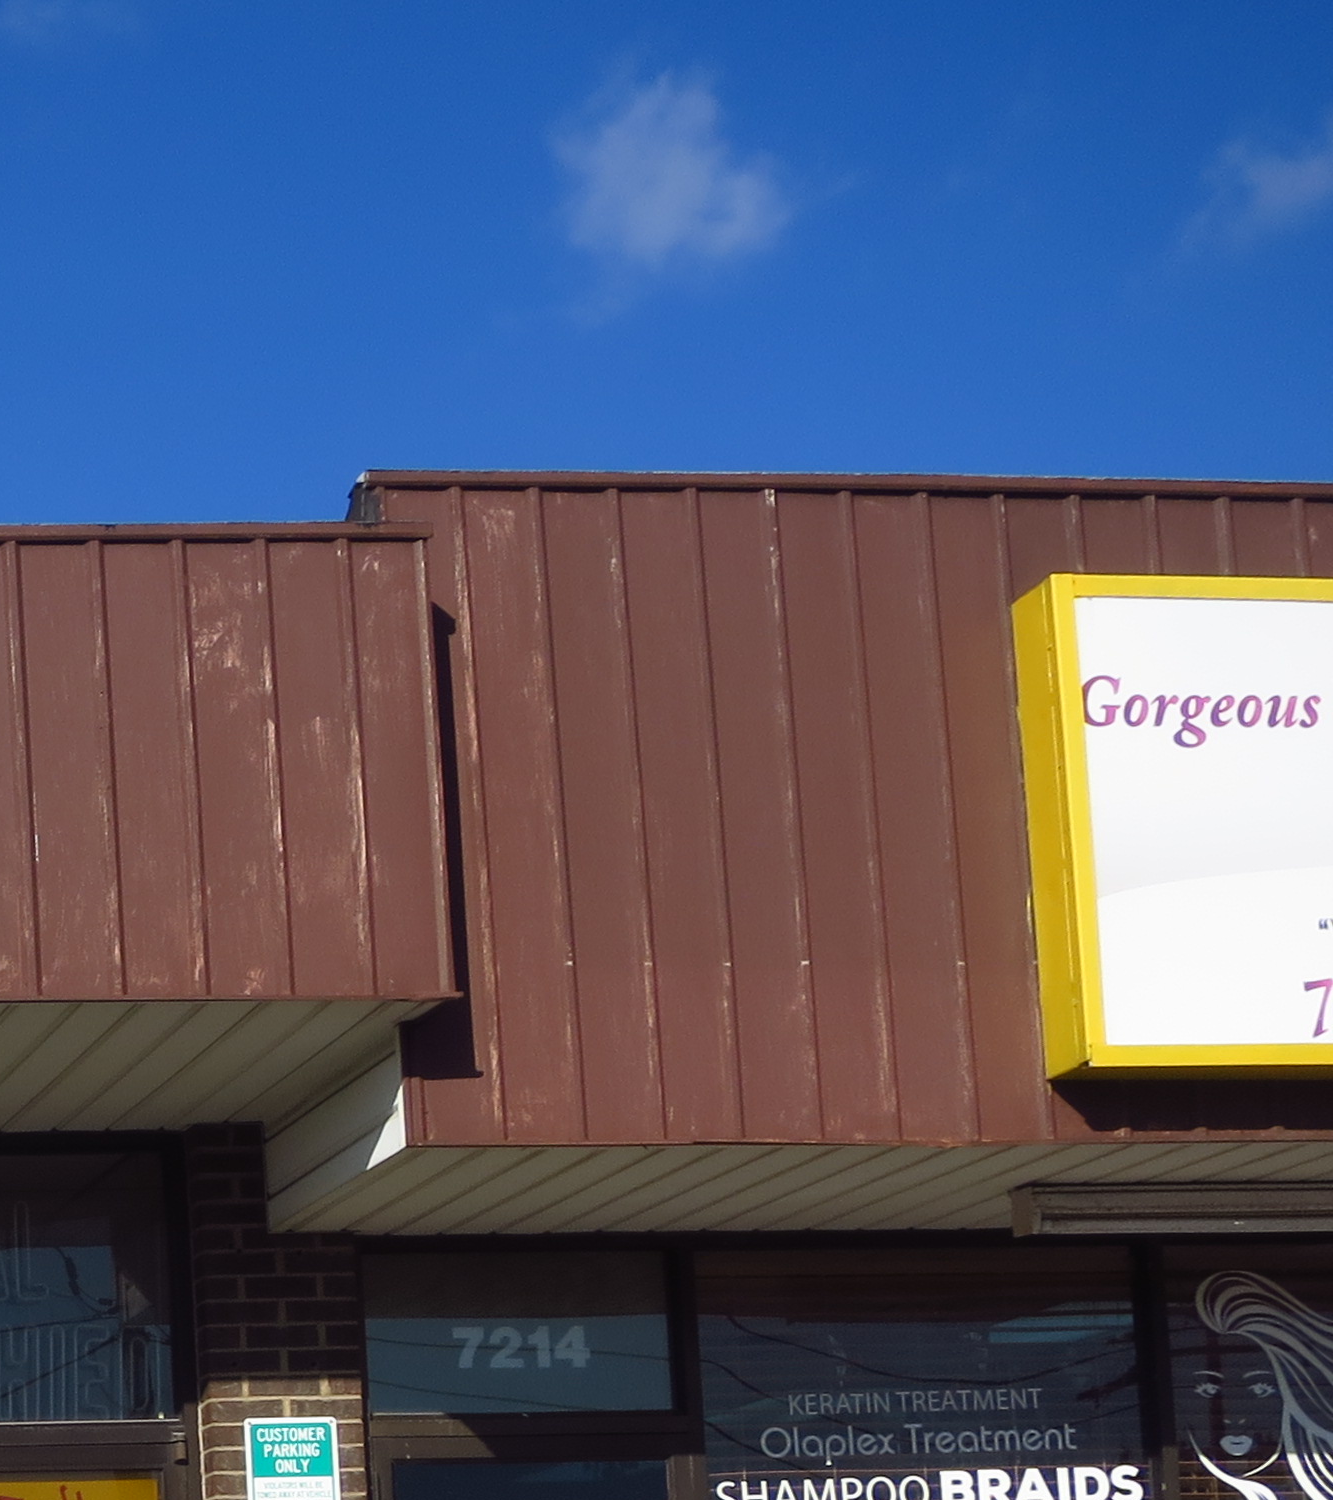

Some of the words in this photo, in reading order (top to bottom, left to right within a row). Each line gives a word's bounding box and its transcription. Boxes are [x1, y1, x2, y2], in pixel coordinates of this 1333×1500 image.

[1081, 674, 1321, 748] Gorgeous
[452, 1325, 590, 1369] 7214
[788, 1392, 890, 1416] KERATIN
[896, 1388, 1043, 1414] TREATMENT
[256, 1427, 325, 1443] CUSTOMER
[760, 1426, 896, 1459] Olaplex
[904, 1423, 1078, 1453] Treatment
[263, 1443, 320, 1458] PARKING
[275, 1458, 310, 1473] ONLY
